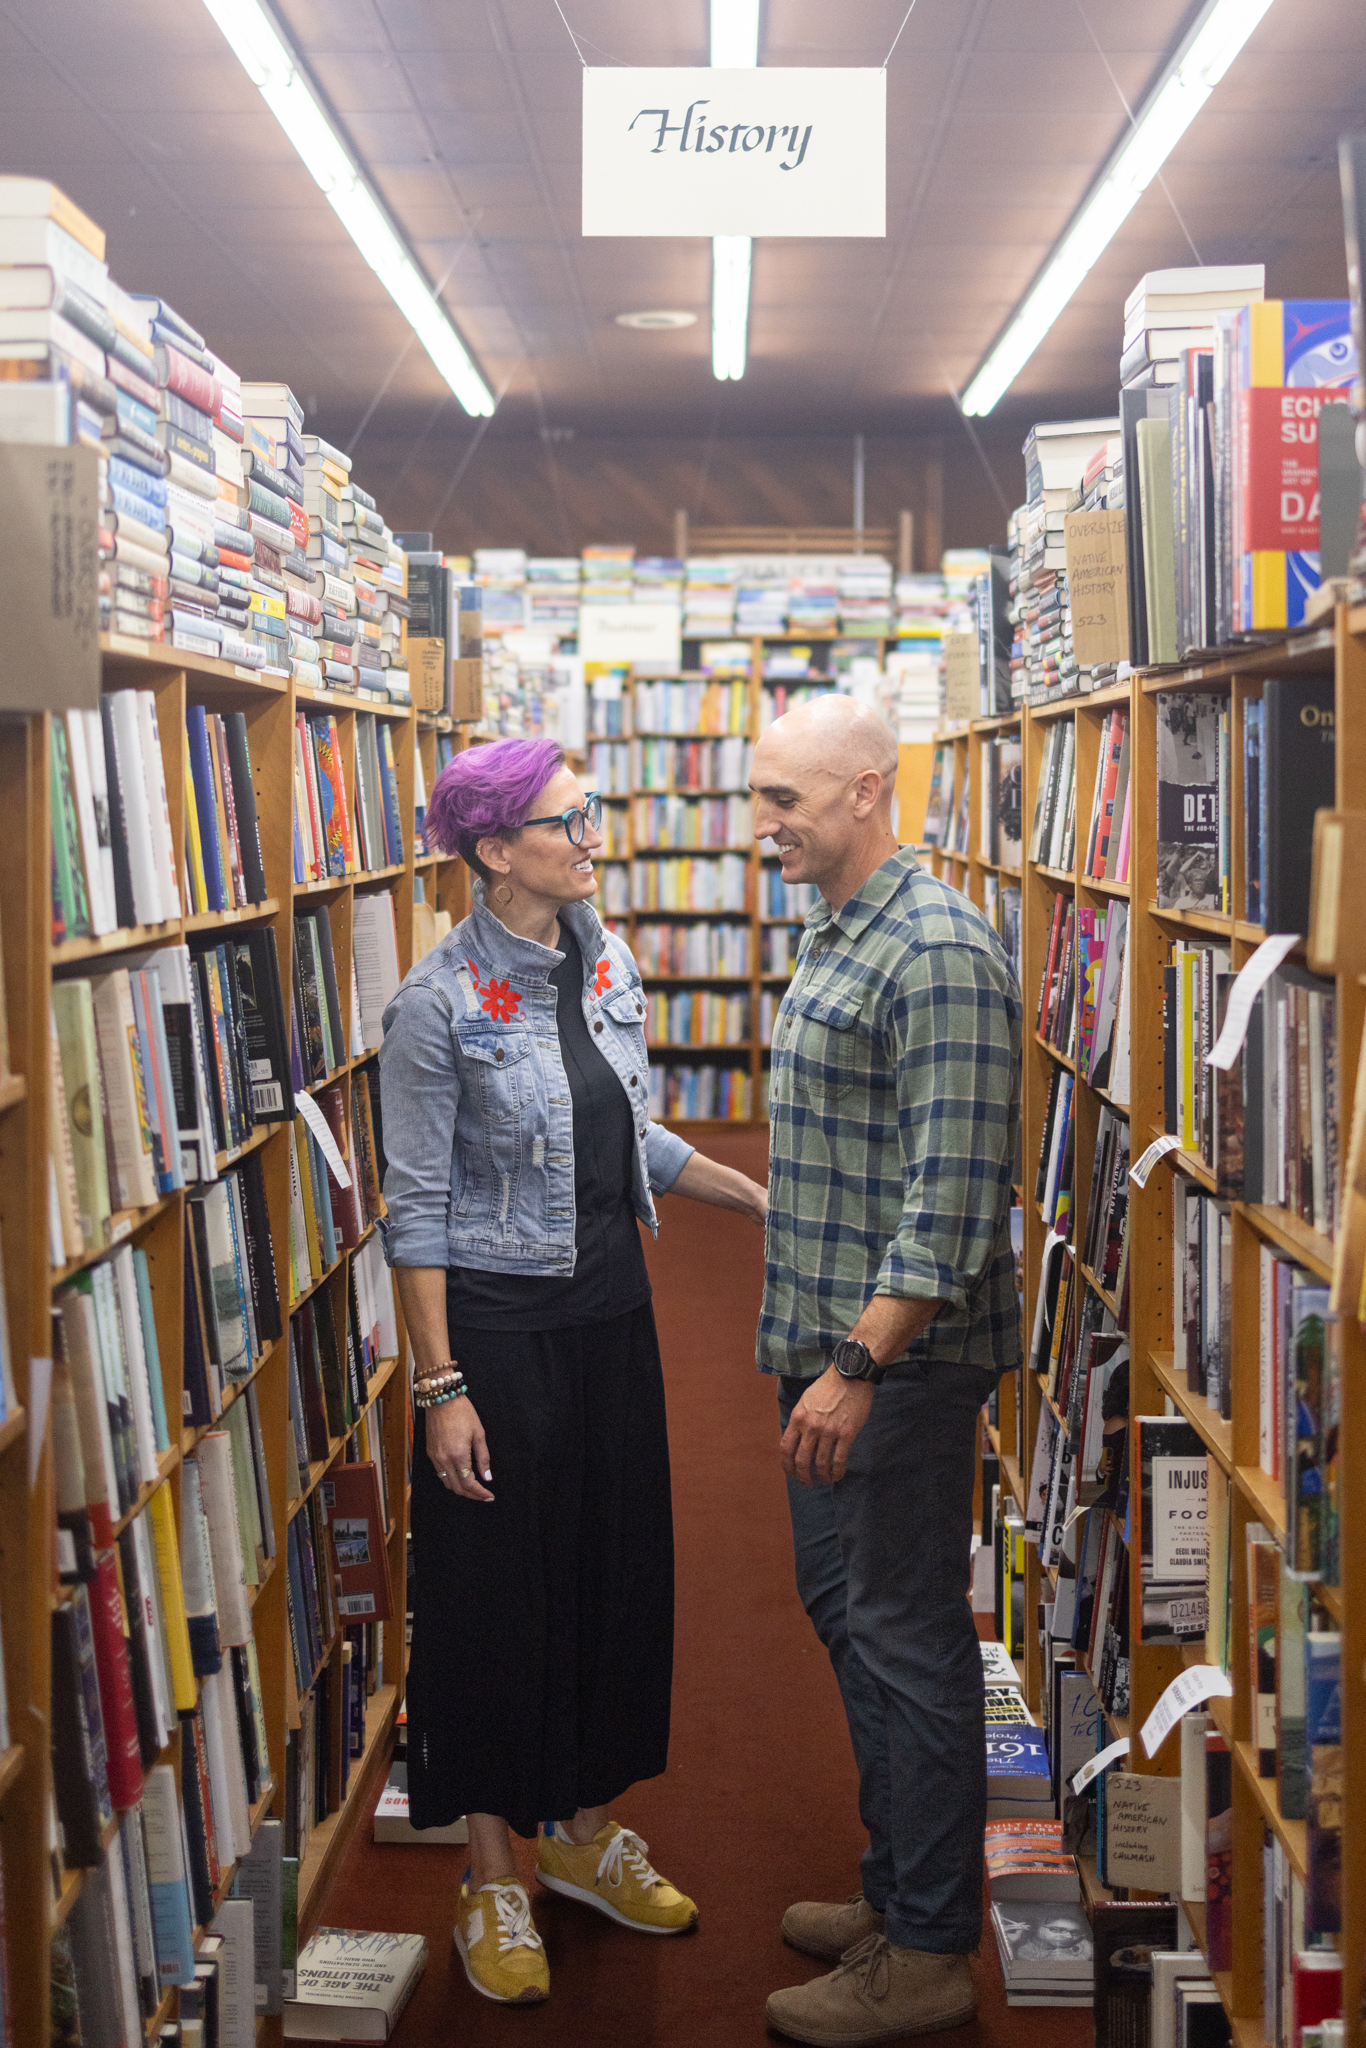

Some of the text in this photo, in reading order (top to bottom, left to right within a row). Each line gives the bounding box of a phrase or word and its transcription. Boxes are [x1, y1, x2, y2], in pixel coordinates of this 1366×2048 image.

[628, 100, 813, 171] History
[1069, 519, 1126, 538] OVERSIZE
[1072, 551, 1107, 567] NATIVE
[1071, 564, 1124, 581] AMERICAN
[1073, 581, 1116, 597] HISTORY
[1075, 614, 1107, 627] 523
[225, 1065, 236, 1111] ADRIATIC
[1169, 1511, 1207, 1519] FOC
[1176, 1548, 1190, 1556] CECIL
[1170, 1558, 1192, 1566] CLAUDIA
[1113, 1778, 1142, 1790] 523
[1112, 1801, 1150, 1811] NATIVE
[1117, 1813, 1168, 1826] AMERICAN
[1112, 1825, 1148, 1833] HISTORY
[1115, 1841, 1148, 1851] including
[298, 1969, 395, 1983] REVOLUTIONS
[321, 1980, 351, 1989] AGE
[353, 1981, 381, 1992] THE
